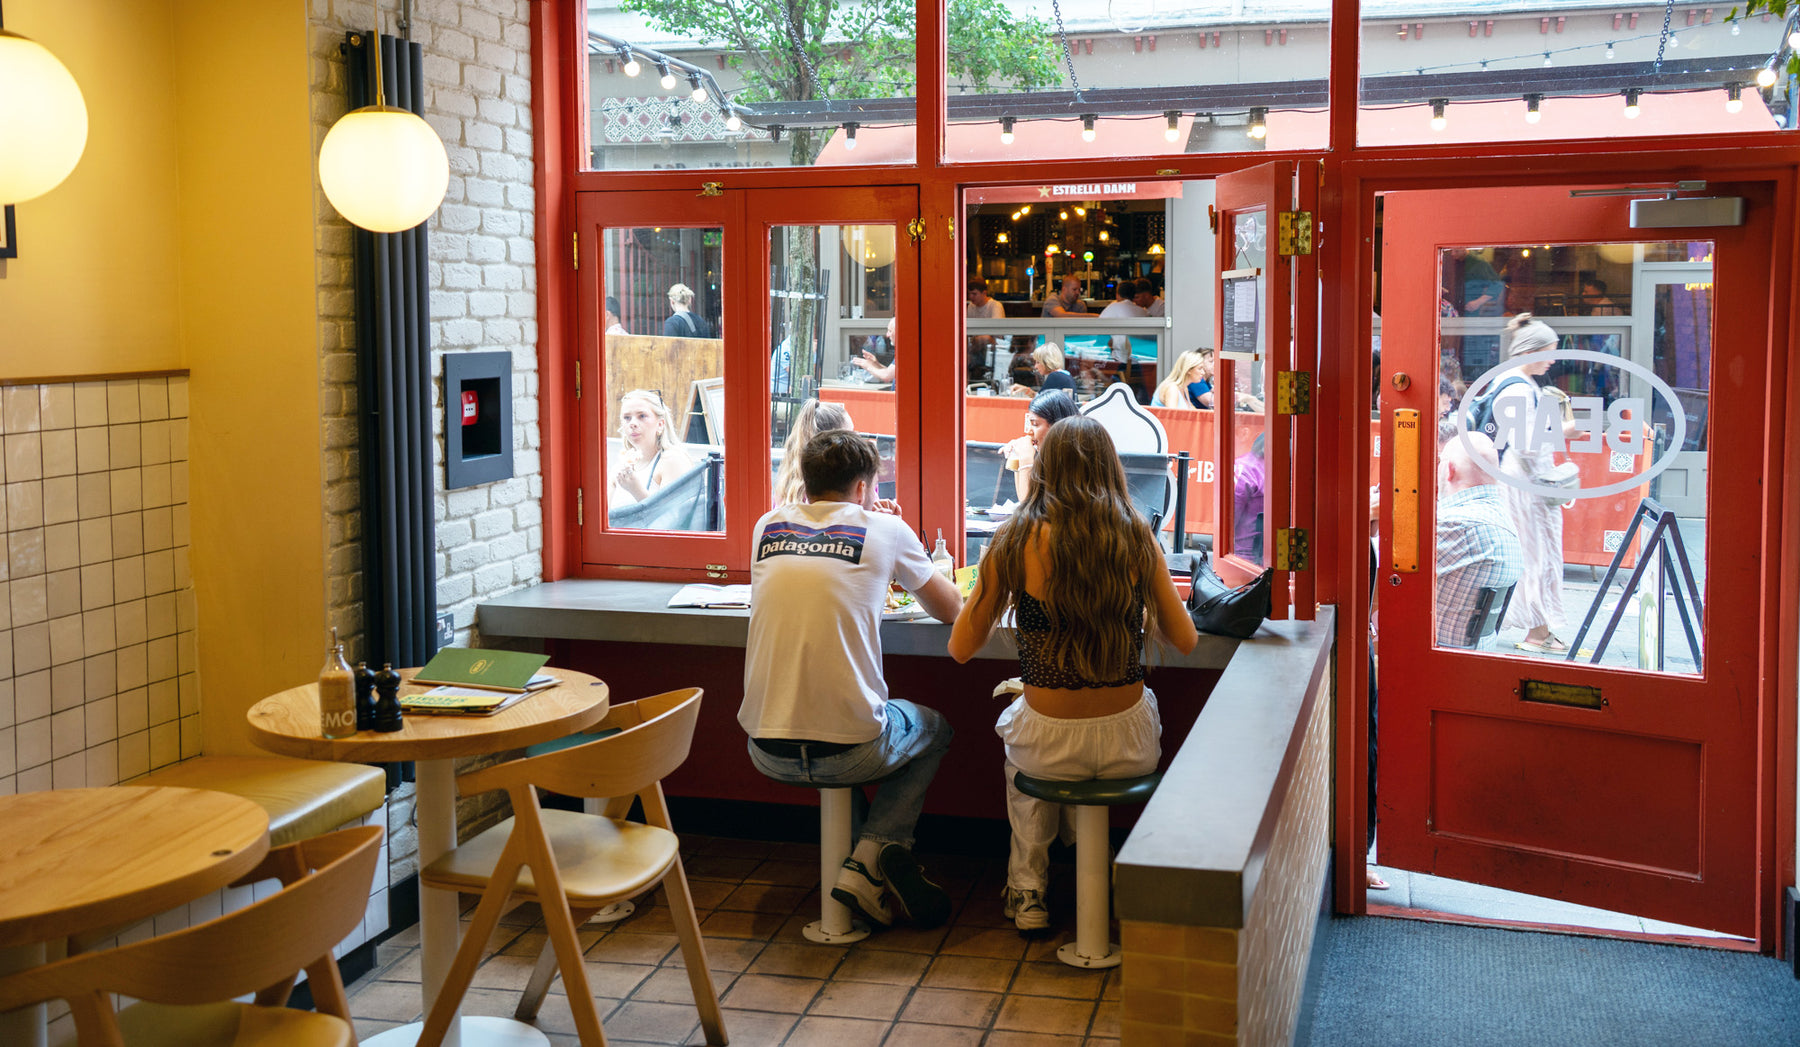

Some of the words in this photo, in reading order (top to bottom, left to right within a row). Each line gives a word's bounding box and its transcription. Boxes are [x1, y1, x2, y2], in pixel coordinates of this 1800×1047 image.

[1053, 184, 1101, 196] ESTRELLA
[1103, 183, 1136, 194] DAMM
[1397, 420, 1416, 429] PUSH
[1196, 460, 1215, 483] IB
[760, 540, 856, 559] patagonia
[320, 709, 357, 728] EMO
